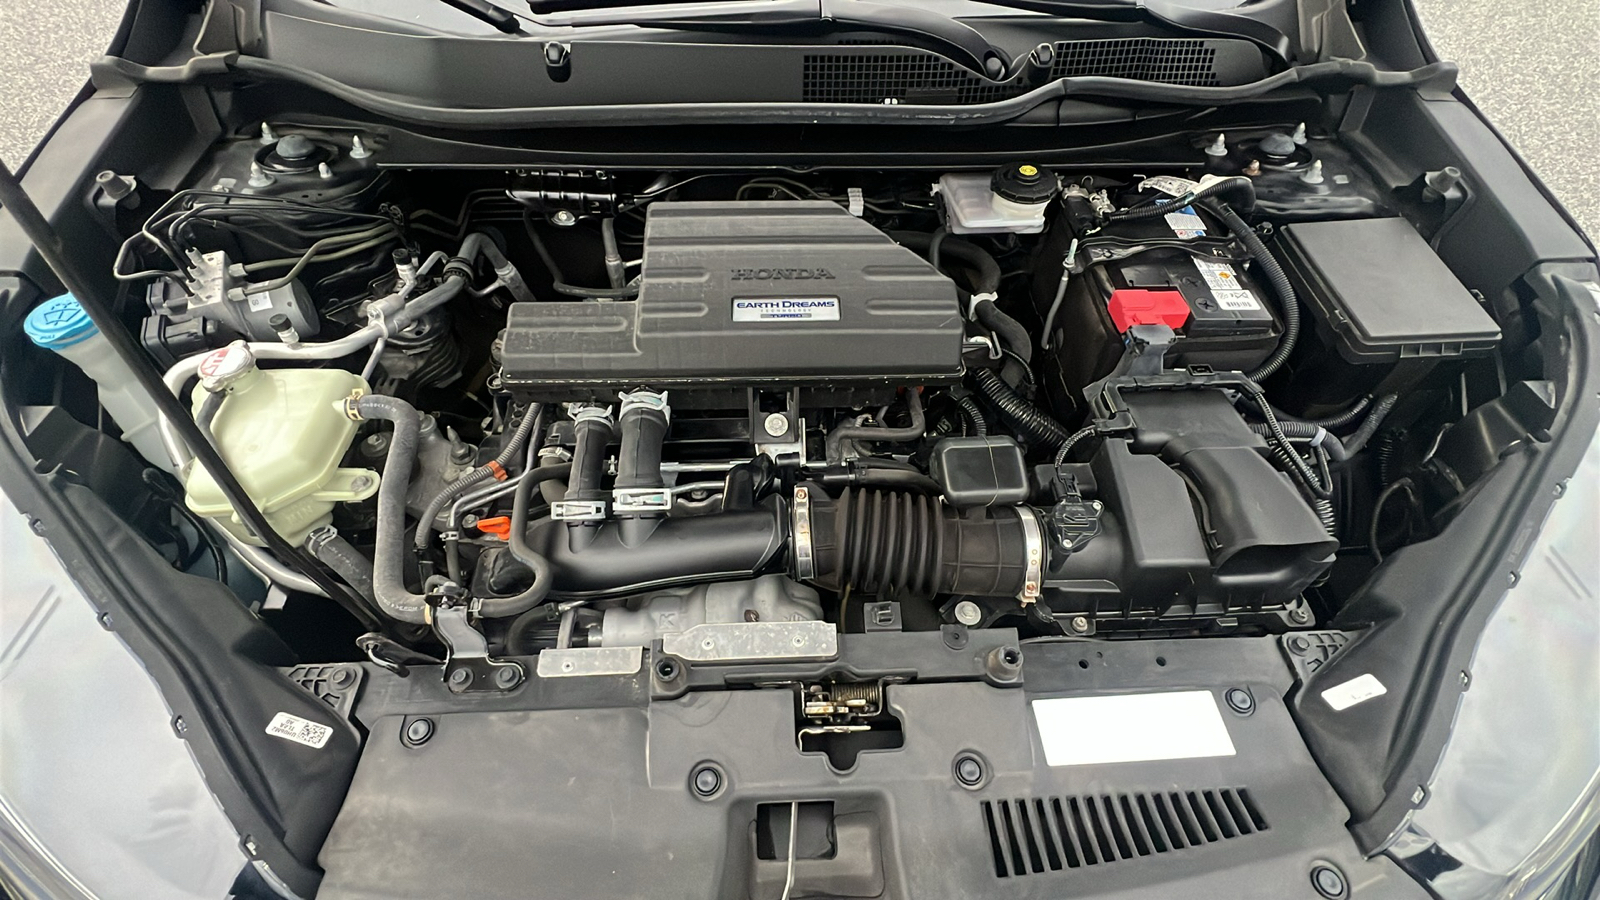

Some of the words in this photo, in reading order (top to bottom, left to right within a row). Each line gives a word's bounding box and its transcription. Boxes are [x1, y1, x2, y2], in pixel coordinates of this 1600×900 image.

[731, 268, 836, 281] HONDA
[737, 301, 780, 309] EARTH
[782, 300, 835, 308] DREAMS
